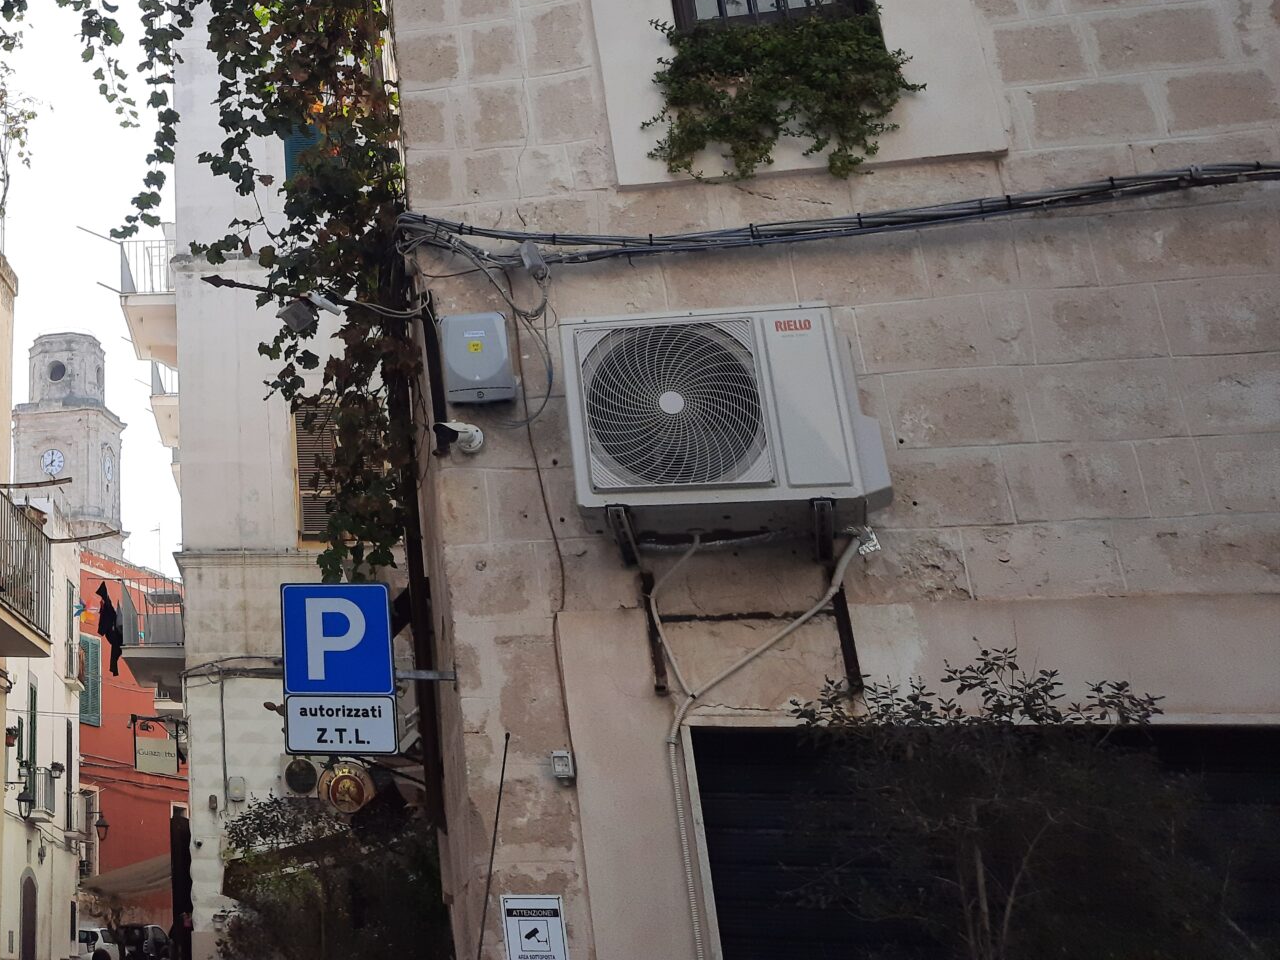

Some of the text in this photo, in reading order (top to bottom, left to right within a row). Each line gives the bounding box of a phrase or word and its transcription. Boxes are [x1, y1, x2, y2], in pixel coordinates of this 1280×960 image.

[774, 319, 812, 332] RIELLO
[305, 597, 366, 680] P
[299, 705, 382, 719] autorizzati
[317, 728, 371, 745] Z.T.L.
[512, 909, 554, 917] ATTENZIONE!
